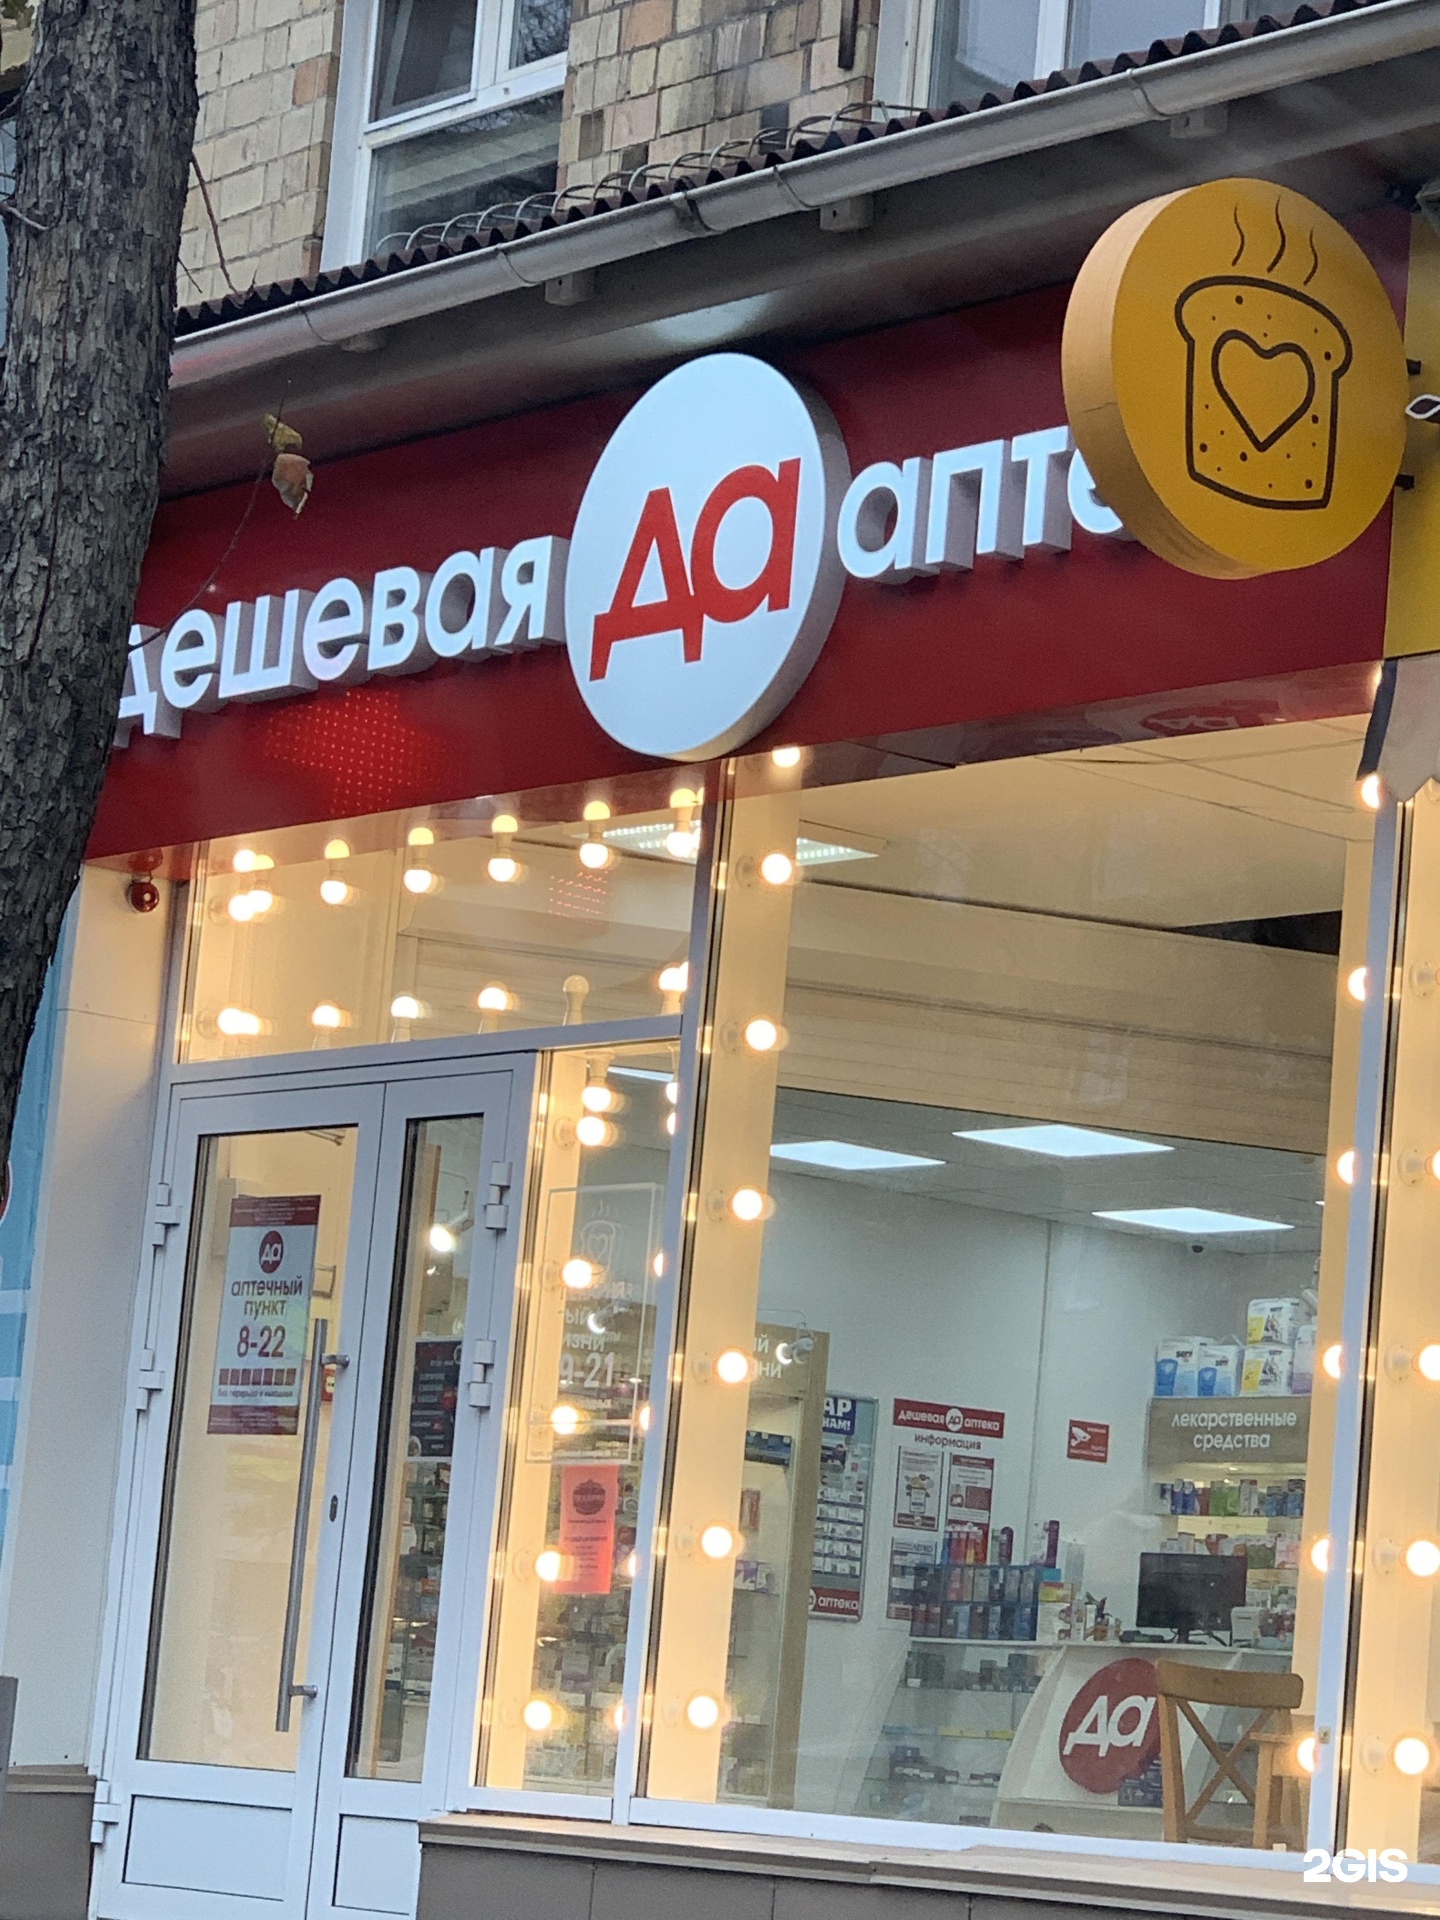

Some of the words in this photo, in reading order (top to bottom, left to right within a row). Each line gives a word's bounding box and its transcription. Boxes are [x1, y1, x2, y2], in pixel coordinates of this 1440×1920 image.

[231, 1276, 302, 1297] аптечный
[243, 1299, 286, 1321] пункт
[236, 1325, 286, 1358] 8-22
[898, 1410, 945, 1425] дешевая
[964, 1418, 1000, 1431] аптека
[1171, 1412, 1297, 1430] лекарственные
[1193, 1433, 1270, 1451] средства
[817, 1596, 859, 1610] аптека
